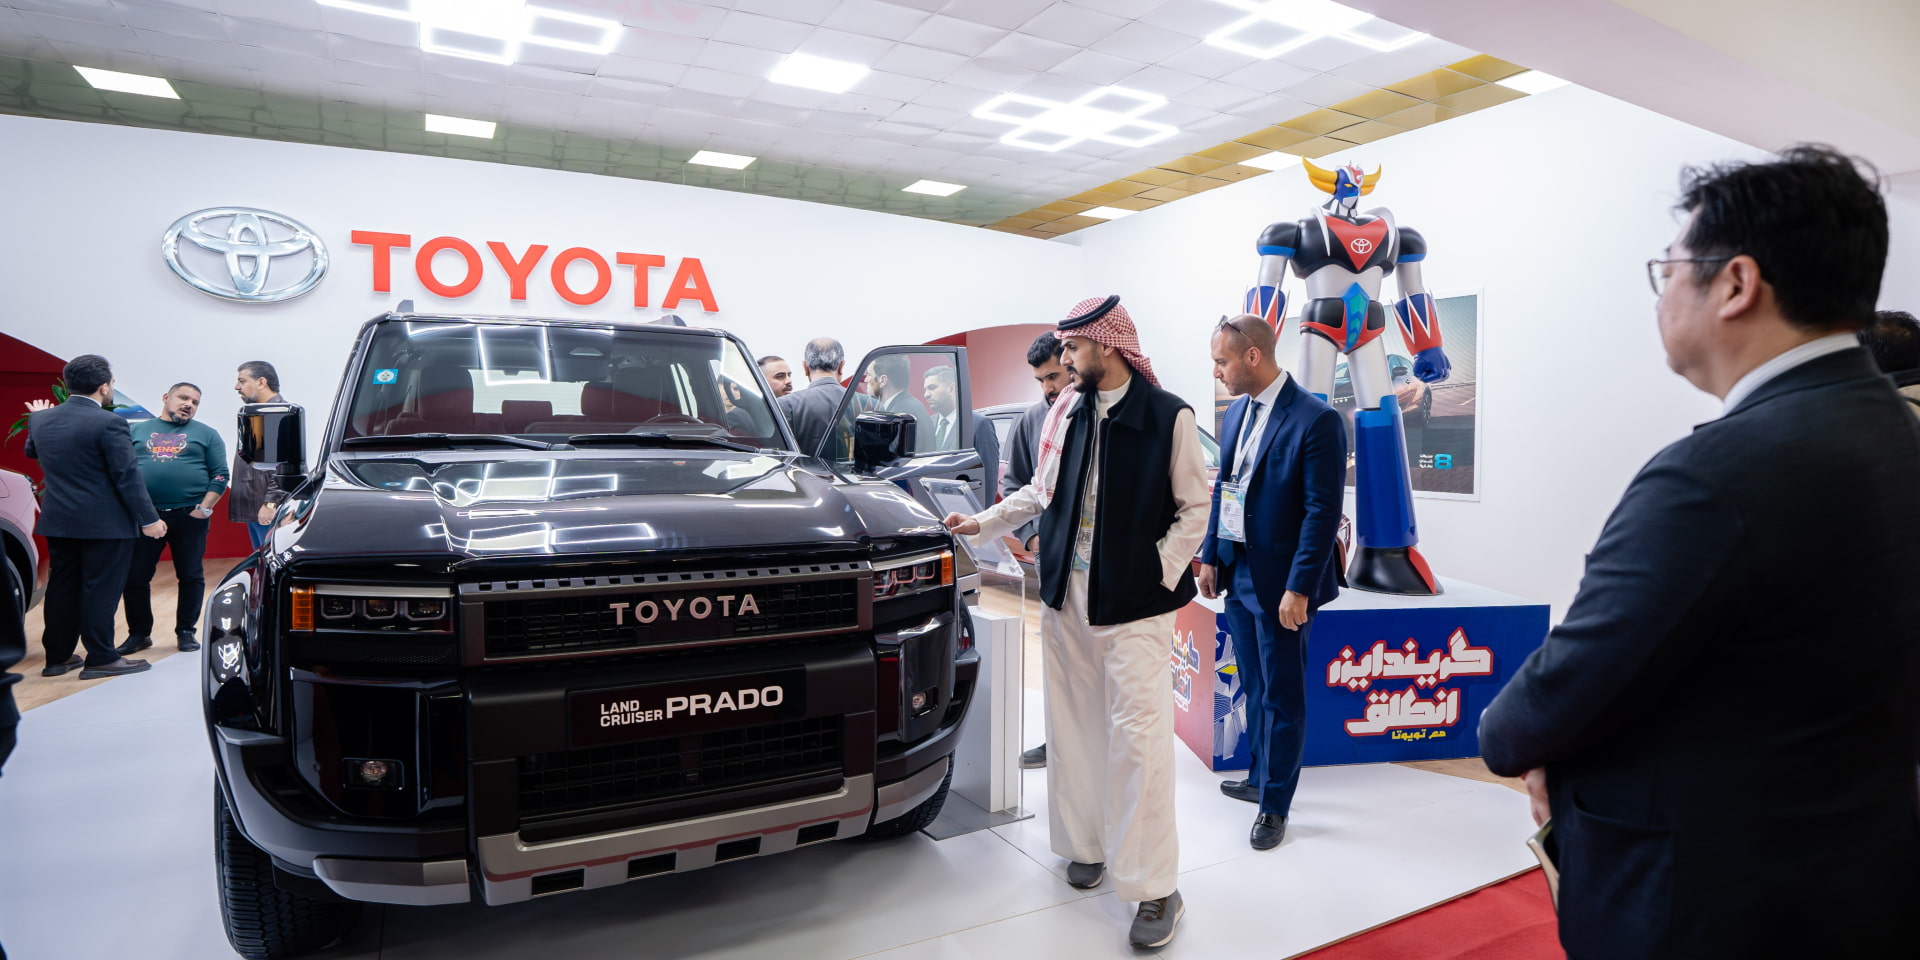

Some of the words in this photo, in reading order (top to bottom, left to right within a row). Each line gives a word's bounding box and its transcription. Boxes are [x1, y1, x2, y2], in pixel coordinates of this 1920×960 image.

[351, 230, 720, 312] TOYOTA
[1434, 453, 1453, 469] 8
[609, 594, 760, 625] TOYOTA
[601, 700, 640, 715] LAND
[666, 685, 784, 719] PRADO
[1346, 687, 1458, 734] انطلق
[600, 709, 663, 727] CRUISER
[1391, 728, 1426, 742] تويوتا
[1428, 730, 1446, 739] مع
